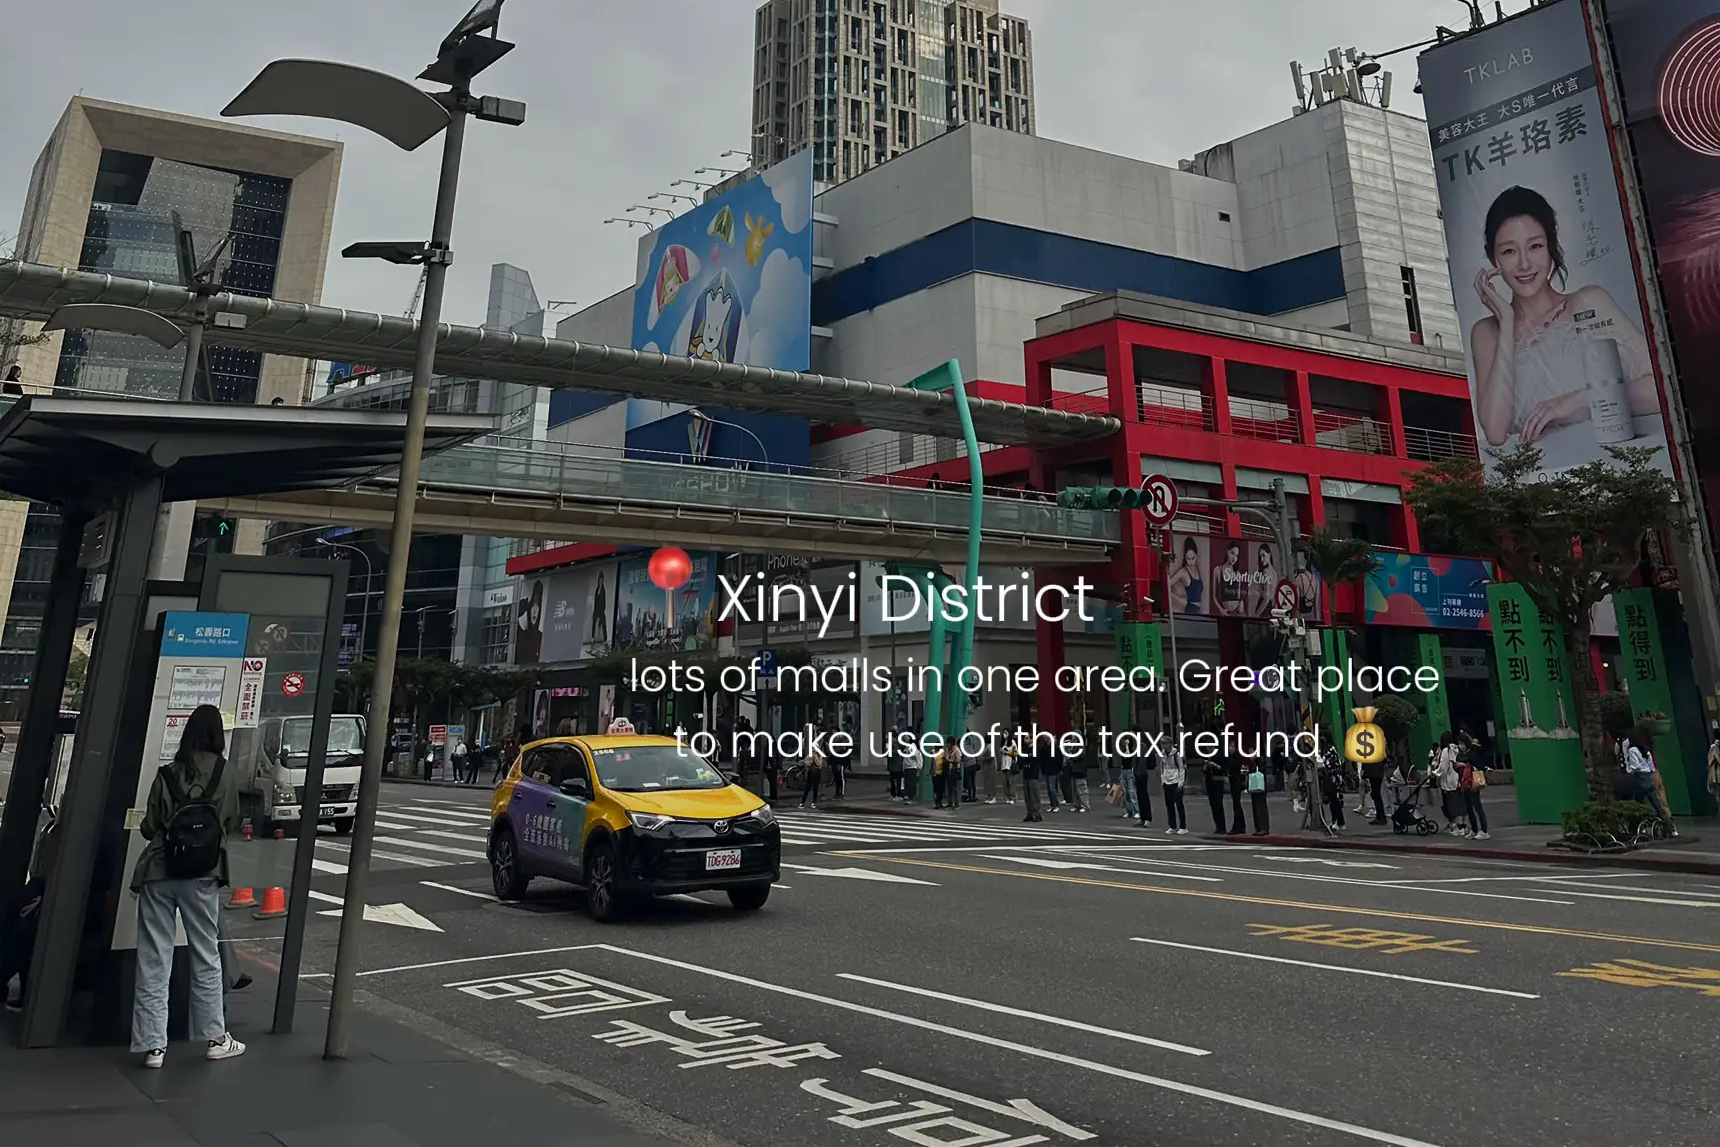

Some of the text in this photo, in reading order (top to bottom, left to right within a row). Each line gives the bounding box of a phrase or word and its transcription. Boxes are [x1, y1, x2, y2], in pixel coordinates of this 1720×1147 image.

[1463, 47, 1534, 85] TKLAB
[1438, 76, 1580, 143] 美容大王 大S唯一代言
[1441, 104, 1588, 183] TK羊珞素
[194, 626, 232, 638] 松壽路口
[1442, 607, 1485, 619] 02-2546-8566
[1498, 598, 1531, 683] 點不到
[1624, 603, 1657, 683] 點得到
